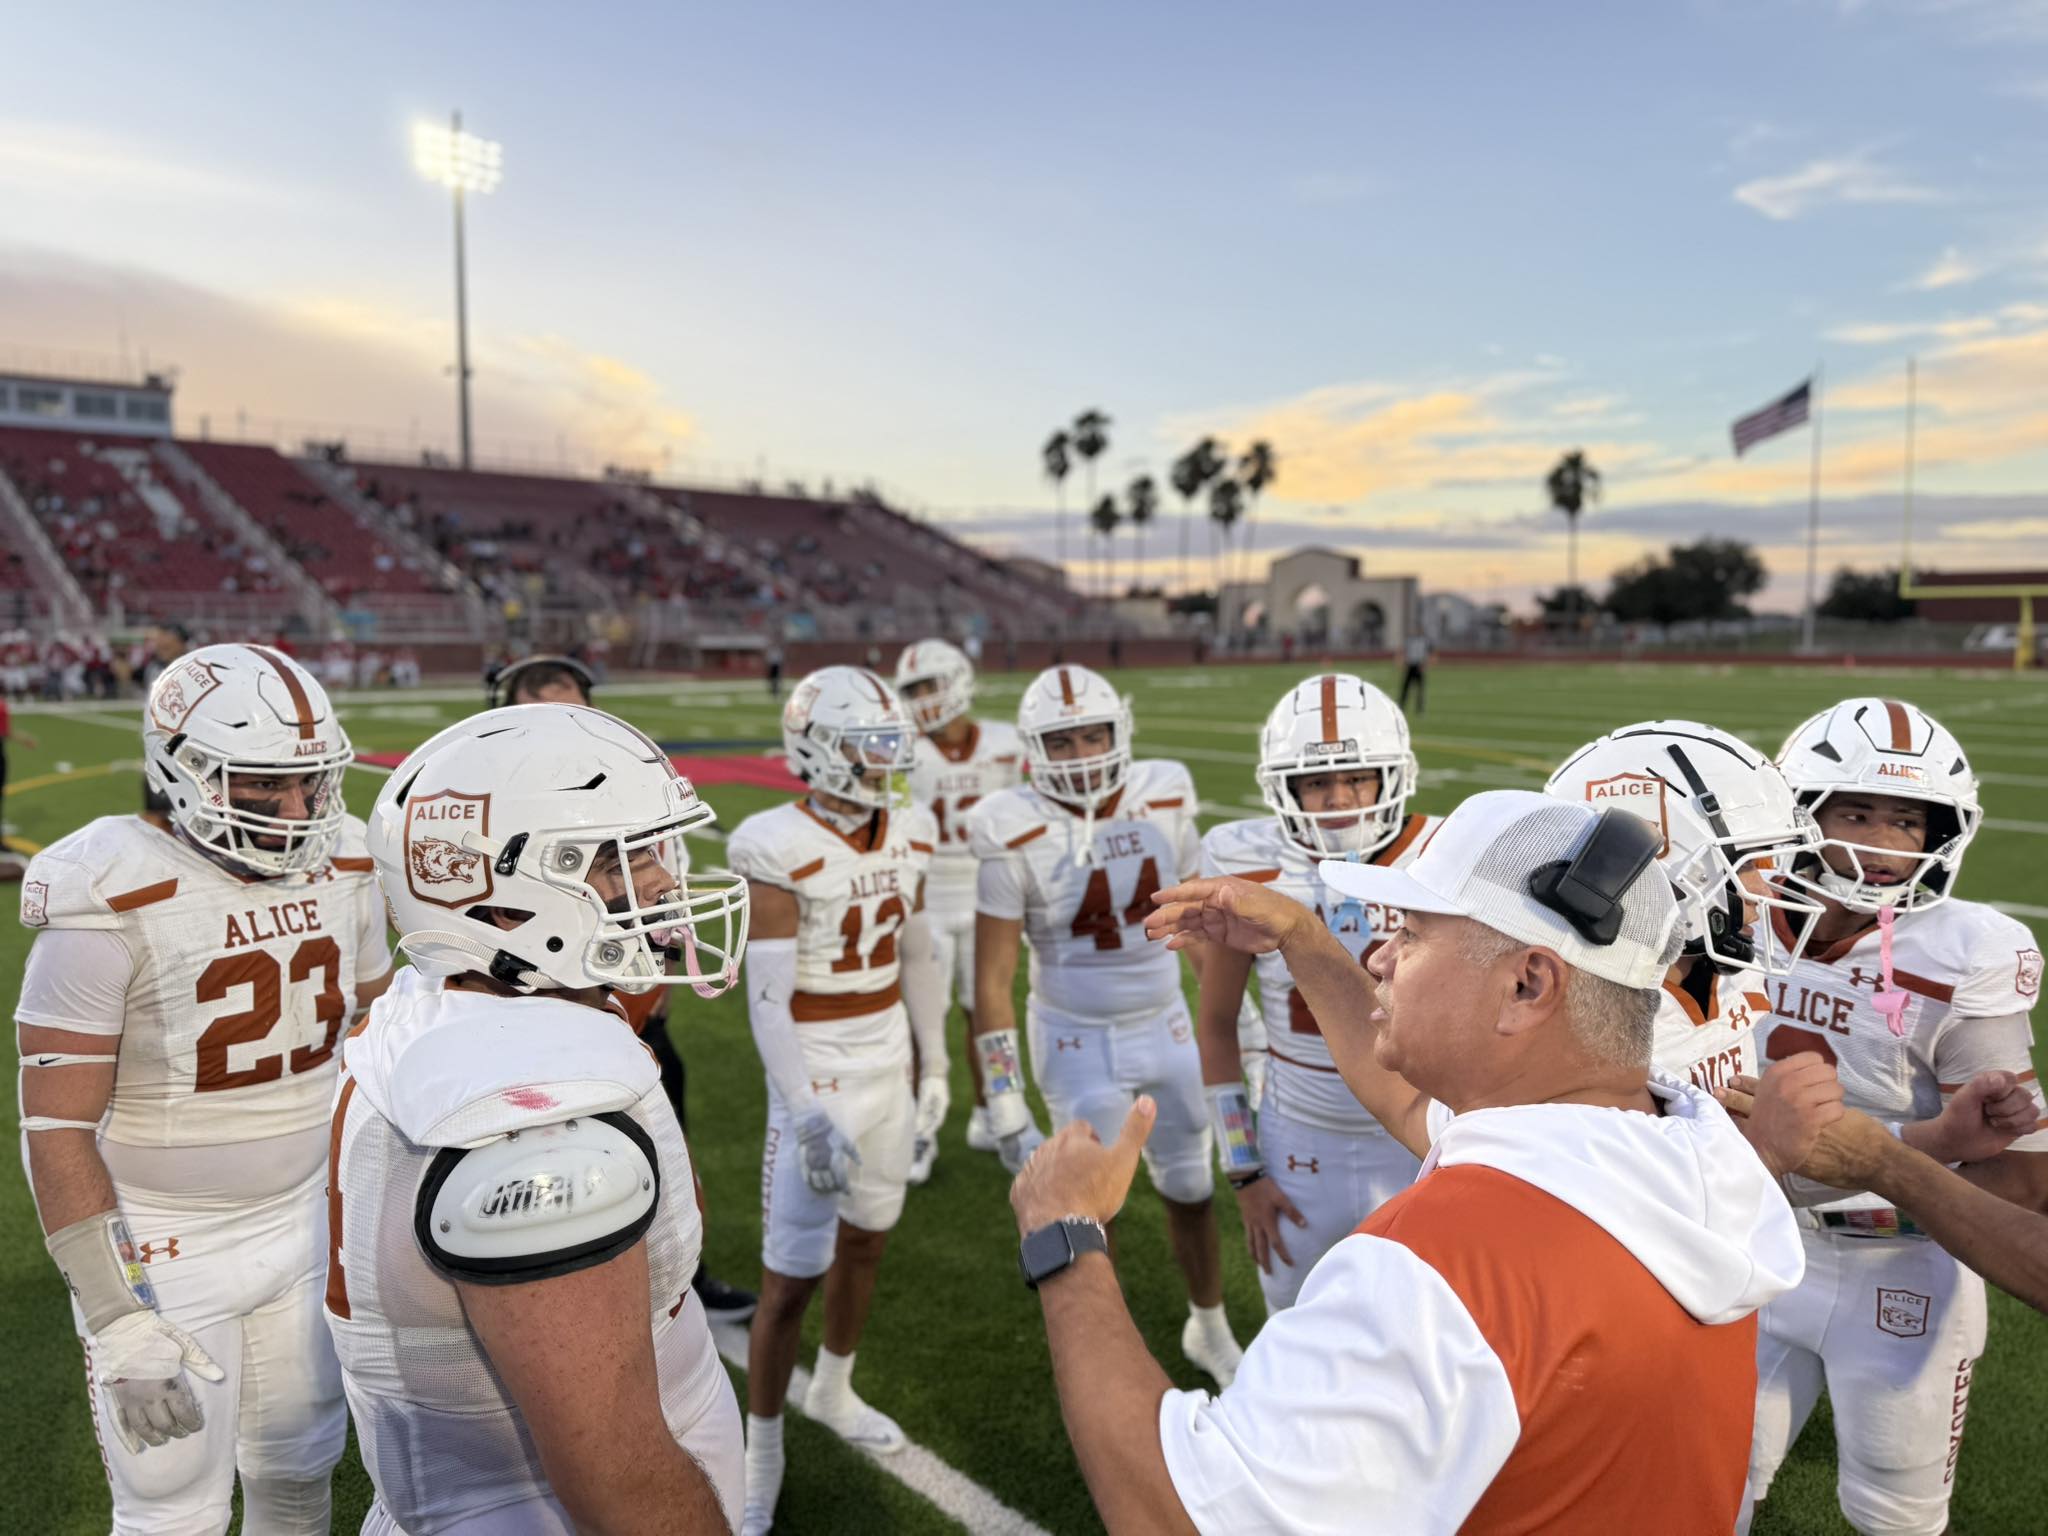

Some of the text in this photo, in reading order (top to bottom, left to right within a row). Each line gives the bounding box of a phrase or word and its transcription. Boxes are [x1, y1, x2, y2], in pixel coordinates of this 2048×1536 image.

[294, 741, 327, 758] ALICE
[1595, 783, 1654, 798] ALICE
[414, 804, 476, 820] ALICE
[1086, 830, 1145, 866] ICE
[849, 868, 899, 901] ALICE
[224, 898, 323, 950] ALICE
[831, 894, 906, 974] 12
[194, 934, 346, 1094] 23
[1764, 978, 1854, 1036] LICE
[1884, 1292, 1923, 1306] ALICE
